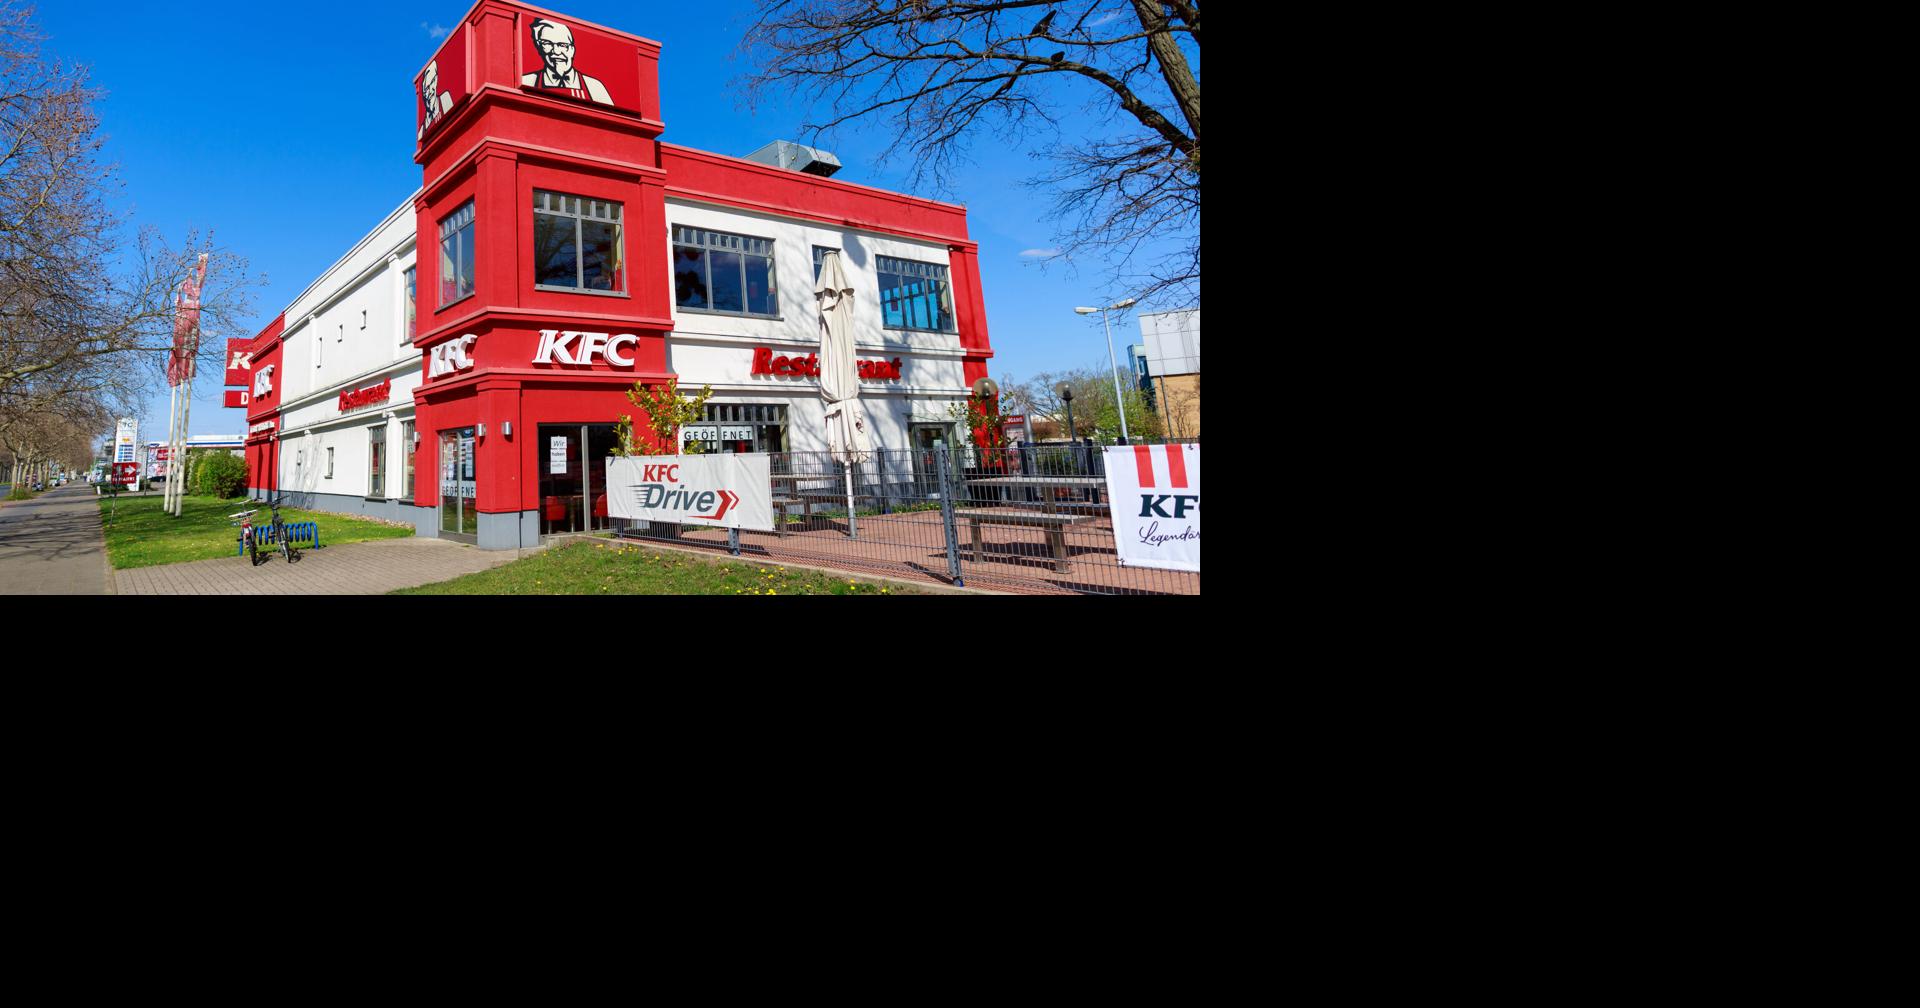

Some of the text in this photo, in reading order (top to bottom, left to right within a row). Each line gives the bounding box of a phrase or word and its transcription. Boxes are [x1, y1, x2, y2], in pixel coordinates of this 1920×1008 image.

[428, 333, 478, 378] KFC
[532, 329, 640, 367] KFC
[752, 347, 902, 380] Restrant
[684, 429, 751, 441] GEÖFFNET
[642, 464, 679, 483] KFC
[643, 483, 715, 512] Drive
[1138, 494, 1200, 519] KF
